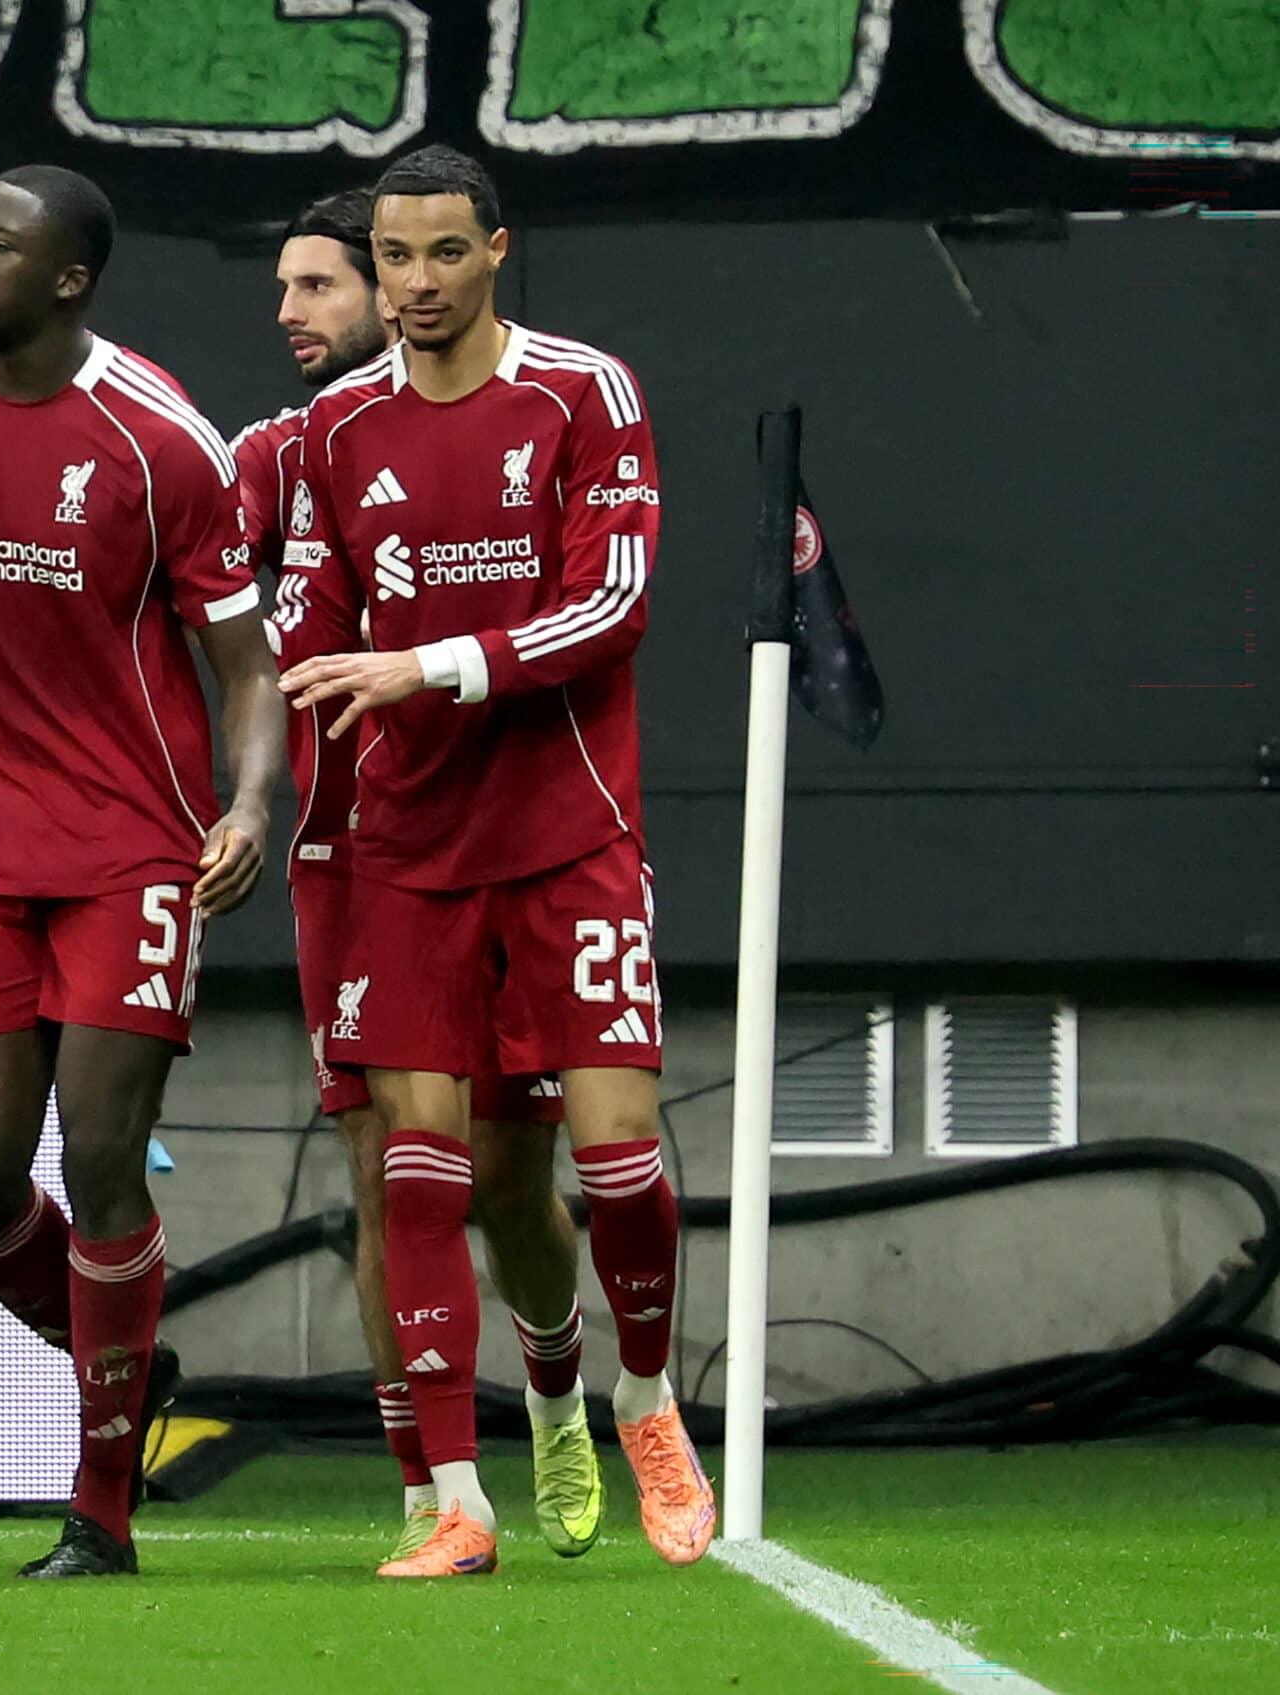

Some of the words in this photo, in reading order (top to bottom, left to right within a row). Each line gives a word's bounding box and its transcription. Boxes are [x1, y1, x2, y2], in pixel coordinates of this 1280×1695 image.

[586, 481, 660, 509] Expeda
[420, 533, 533, 565] standard
[422, 555, 541, 586] chartered
[138, 884, 181, 966] 5
[573, 918, 654, 1006] 22
[396, 1306, 450, 1326] LFC
[85, 1361, 137, 1386] LFC
